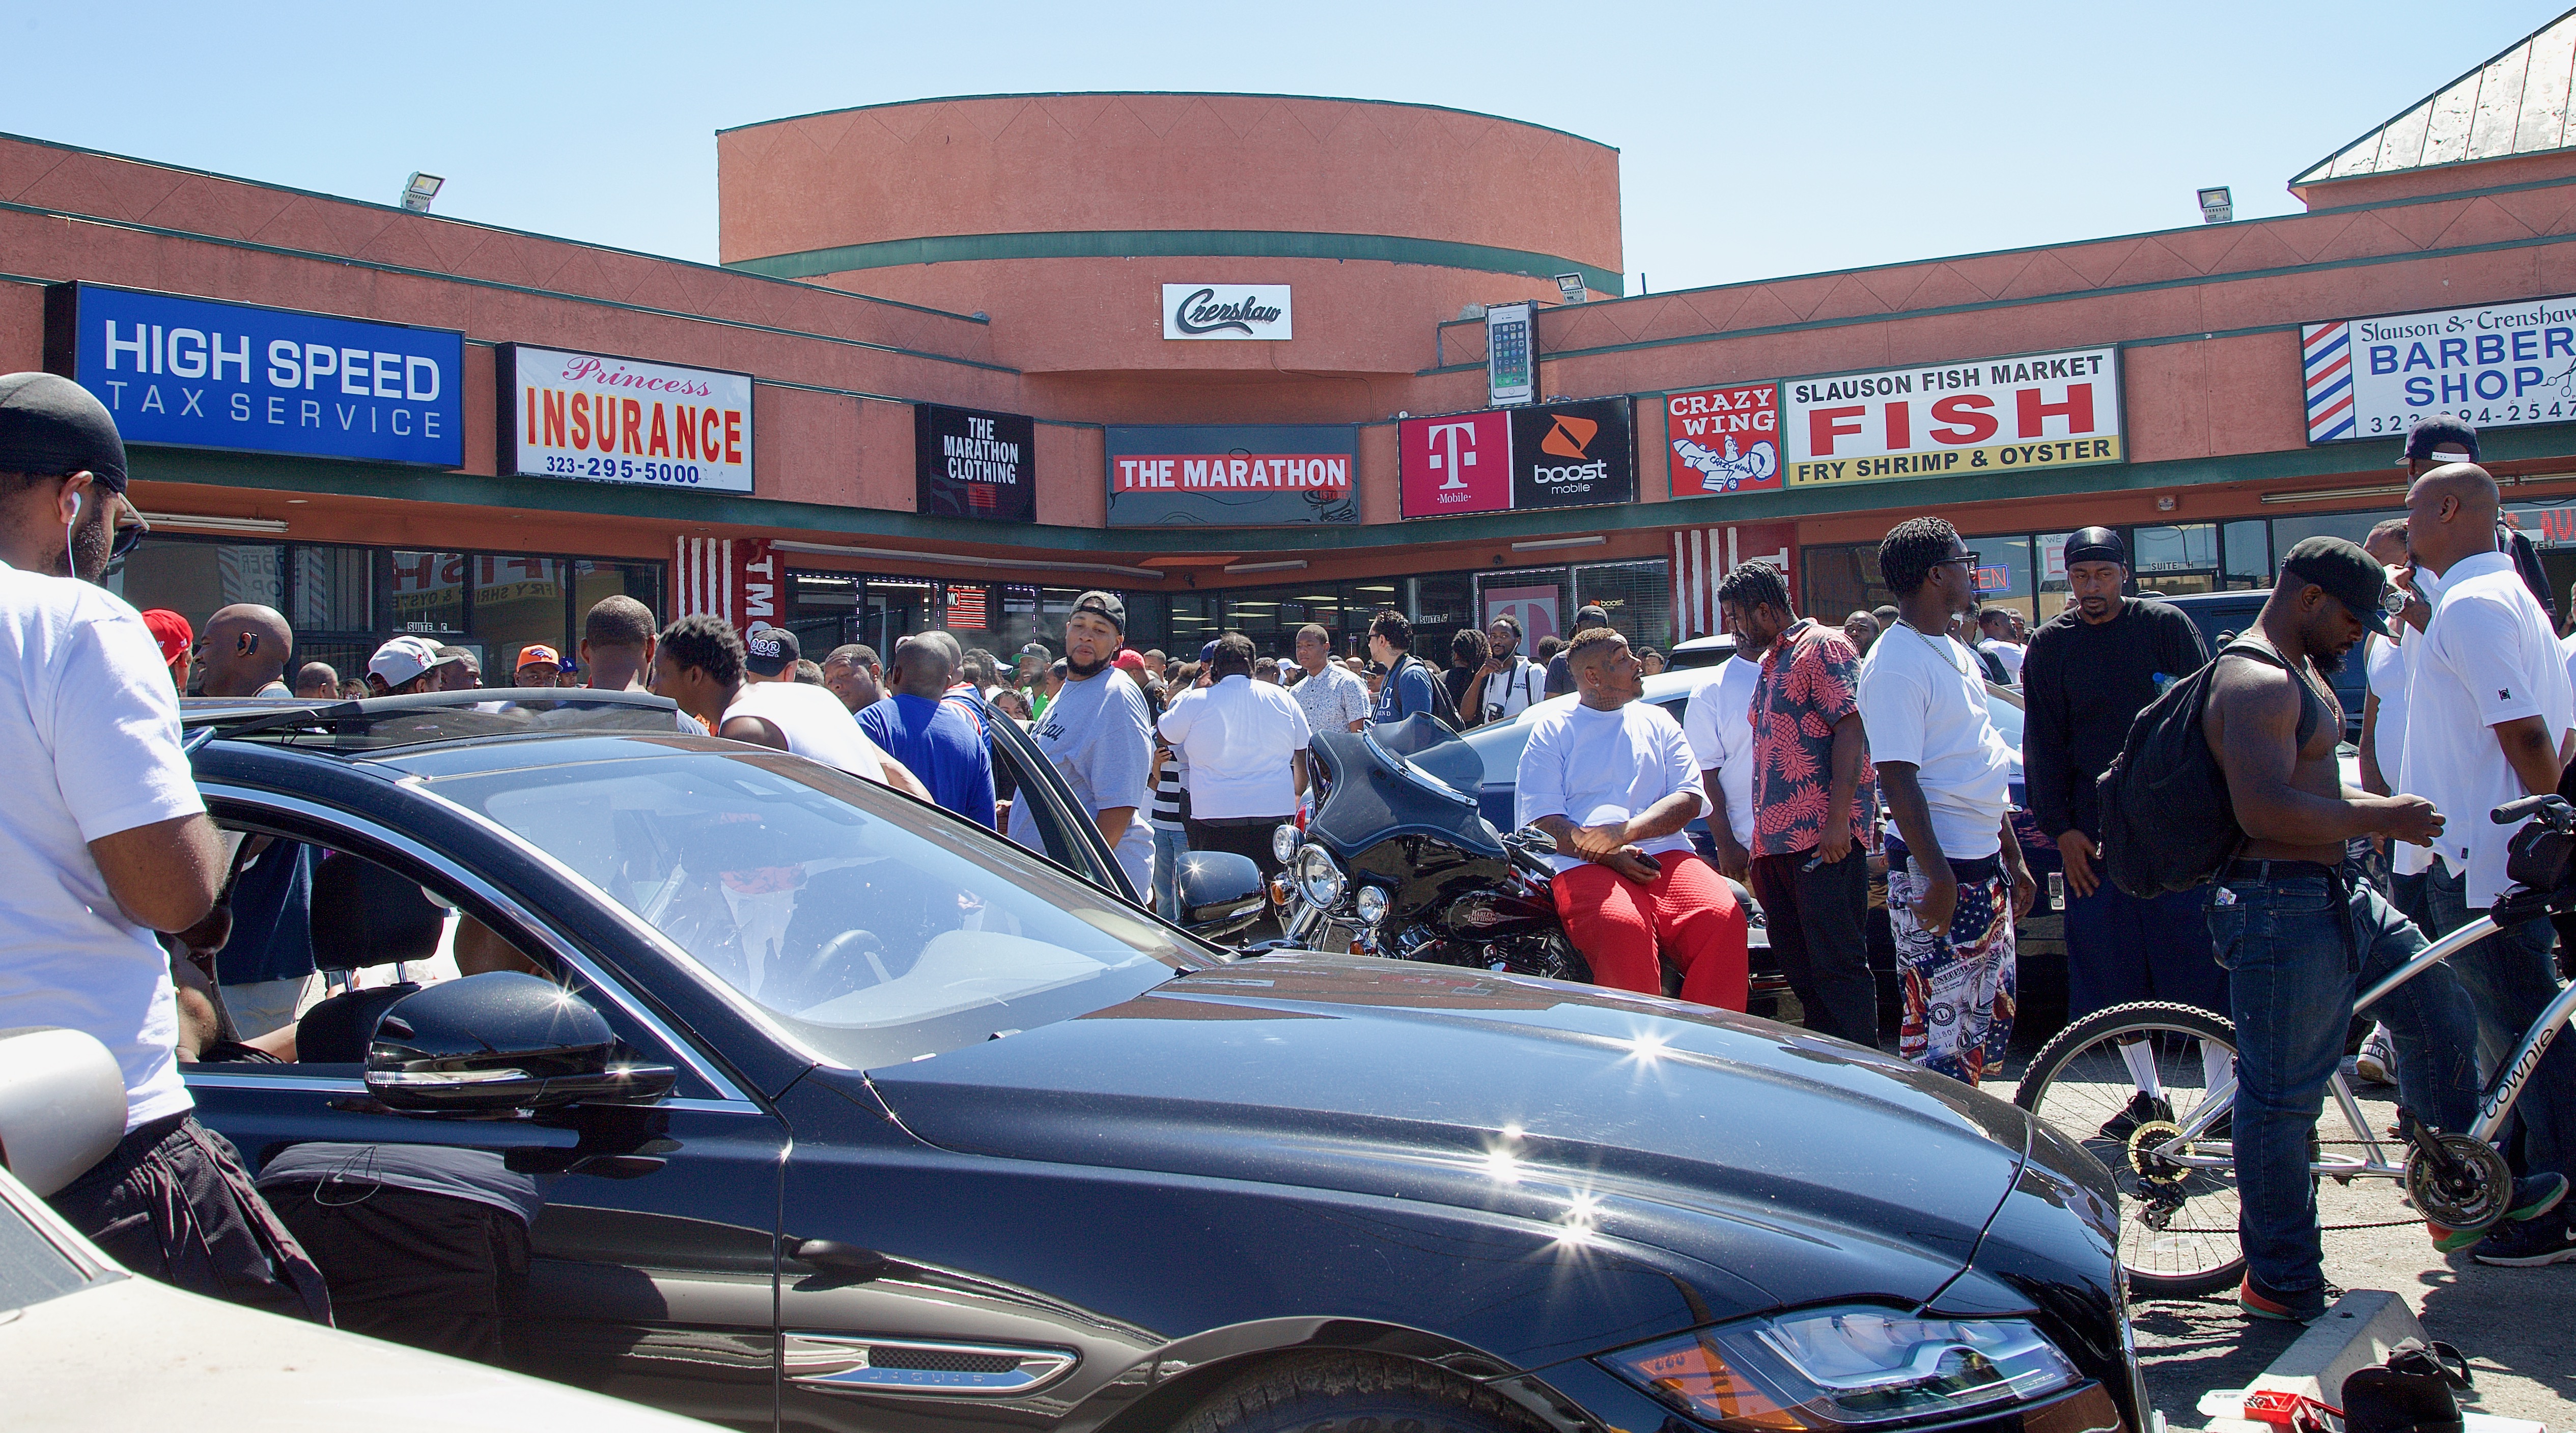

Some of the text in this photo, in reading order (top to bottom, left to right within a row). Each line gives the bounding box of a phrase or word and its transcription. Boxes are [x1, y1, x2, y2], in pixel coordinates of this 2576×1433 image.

[2361, 322, 2440, 342] Slauson
[2446, 316, 2473, 333] &
[106, 320, 440, 402] HIGH SPEED
[2370, 327, 2576, 376] BARBER
[563, 356, 712, 397] Princess
[1795, 355, 2103, 403] SLAUSON FISH MARKET
[2404, 367, 2544, 407] SHOP
[106, 380, 441, 439] TAX SERVICE
[1670, 388, 1774, 416] CRAZY
[526, 386, 743, 466] INSURANCE
[968, 417, 994, 440] THE
[1683, 410, 1775, 436] WING
[1809, 383, 2094, 457] FISH
[944, 435, 1019, 464] MARATHON
[1710, 456, 1734, 470] CRAZY
[1798, 439, 2111, 482] FRY SHRIMP & OYSTER
[546, 456, 698, 484] 323-295-5000
[948, 458, 1016, 485] CLOTHING
[1119, 459, 1346, 487] THE MARATHON
[1534, 459, 1607, 484] boost
[1551, 483, 1590, 494] mobile
[2046, 535, 2061, 543] WE
[1977, 568, 2007, 589] EN
[2150, 561, 2178, 571] SUITE
[1600, 598, 1625, 606] boost
[408, 623, 447, 632] SUITE C
[2362, 1044, 2385, 1059] NIKE
[2482, 1027, 2555, 1119] townie
[869, 1370, 986, 1384] JAGUAR
